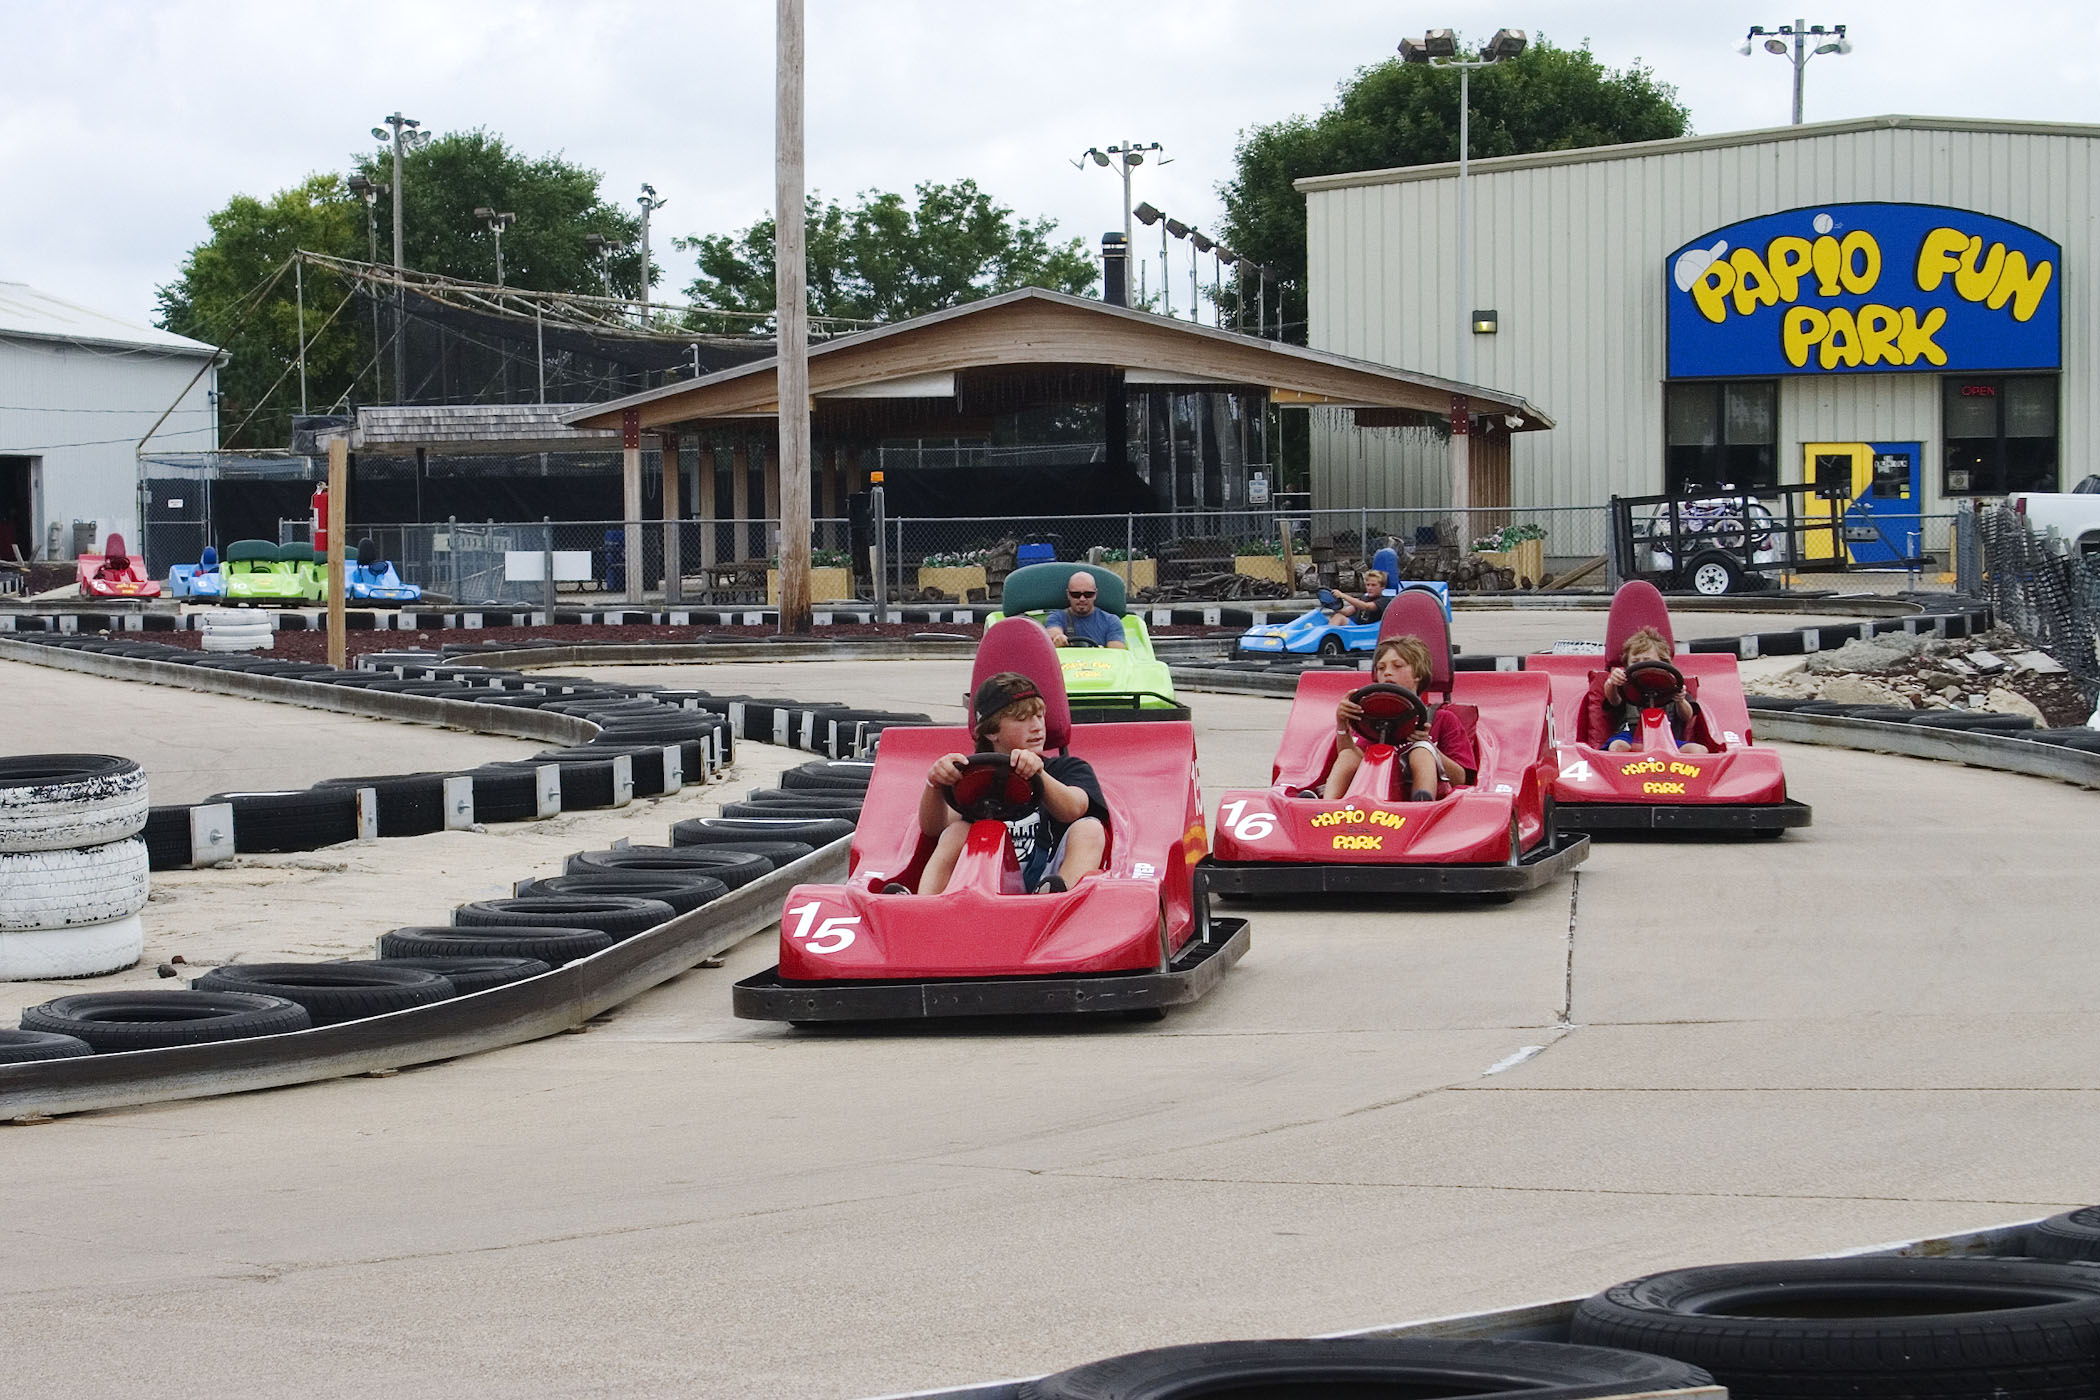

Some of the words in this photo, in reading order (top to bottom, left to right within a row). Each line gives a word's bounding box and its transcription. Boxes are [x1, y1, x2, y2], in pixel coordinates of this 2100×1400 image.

[1690, 228, 1882, 324] PAPIO
[1916, 227, 2053, 323] FUN
[1782, 303, 1948, 370] PARK
[1961, 385, 1995, 396] OPEN
[1670, 761, 1701, 778] FUN
[1642, 782, 1686, 795] PARK
[1220, 799, 1277, 841] 16
[1310, 809, 1366, 828] PAPIO
[1369, 810, 1407, 830] FUN
[1332, 835, 1383, 850] PARK
[788, 901, 862, 954] 15
